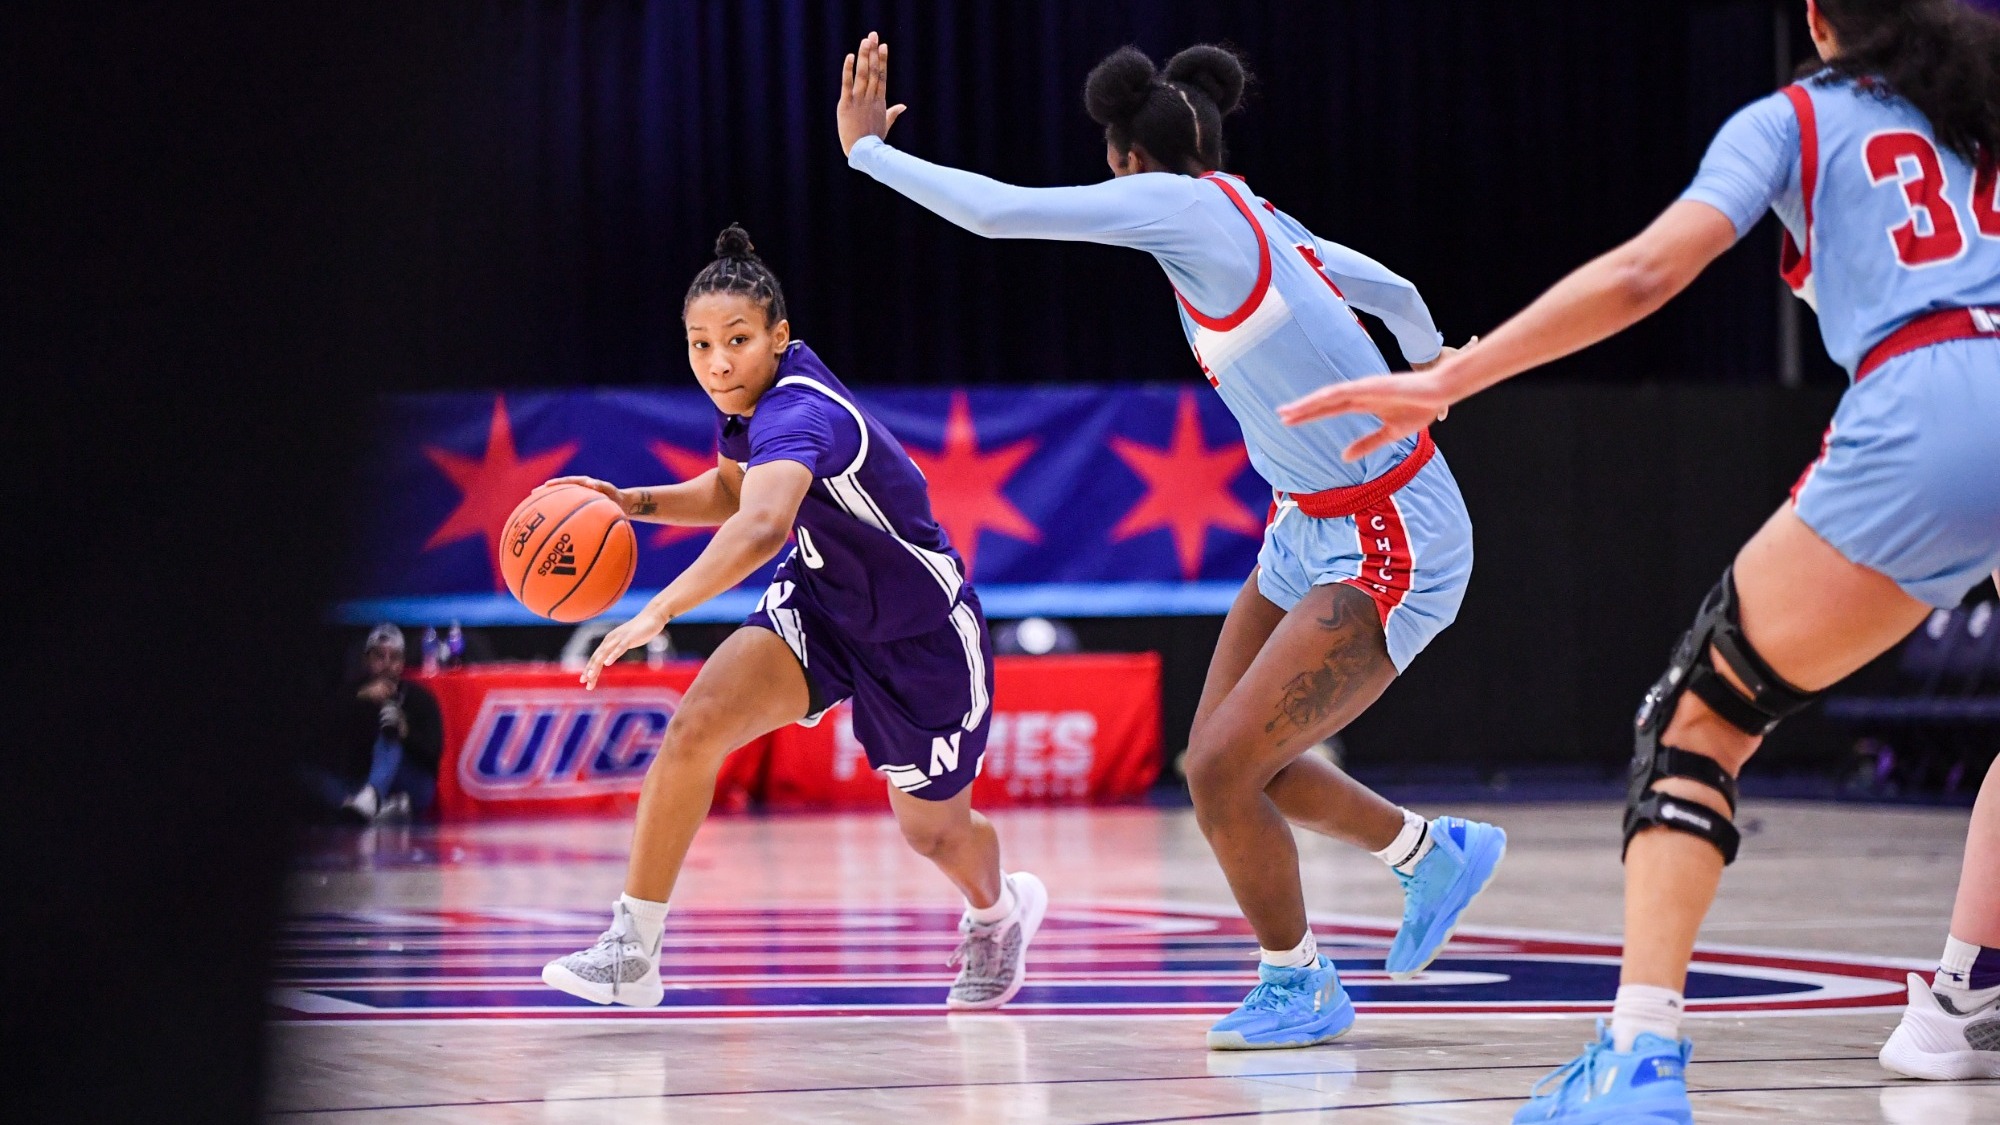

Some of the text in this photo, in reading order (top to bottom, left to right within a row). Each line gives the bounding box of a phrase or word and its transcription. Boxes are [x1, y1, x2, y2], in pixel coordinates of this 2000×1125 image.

[512, 512, 546, 558] PRO
[537, 533, 571, 576] adidas
[472, 705, 669, 784] UIC
[929, 721, 962, 777] N
